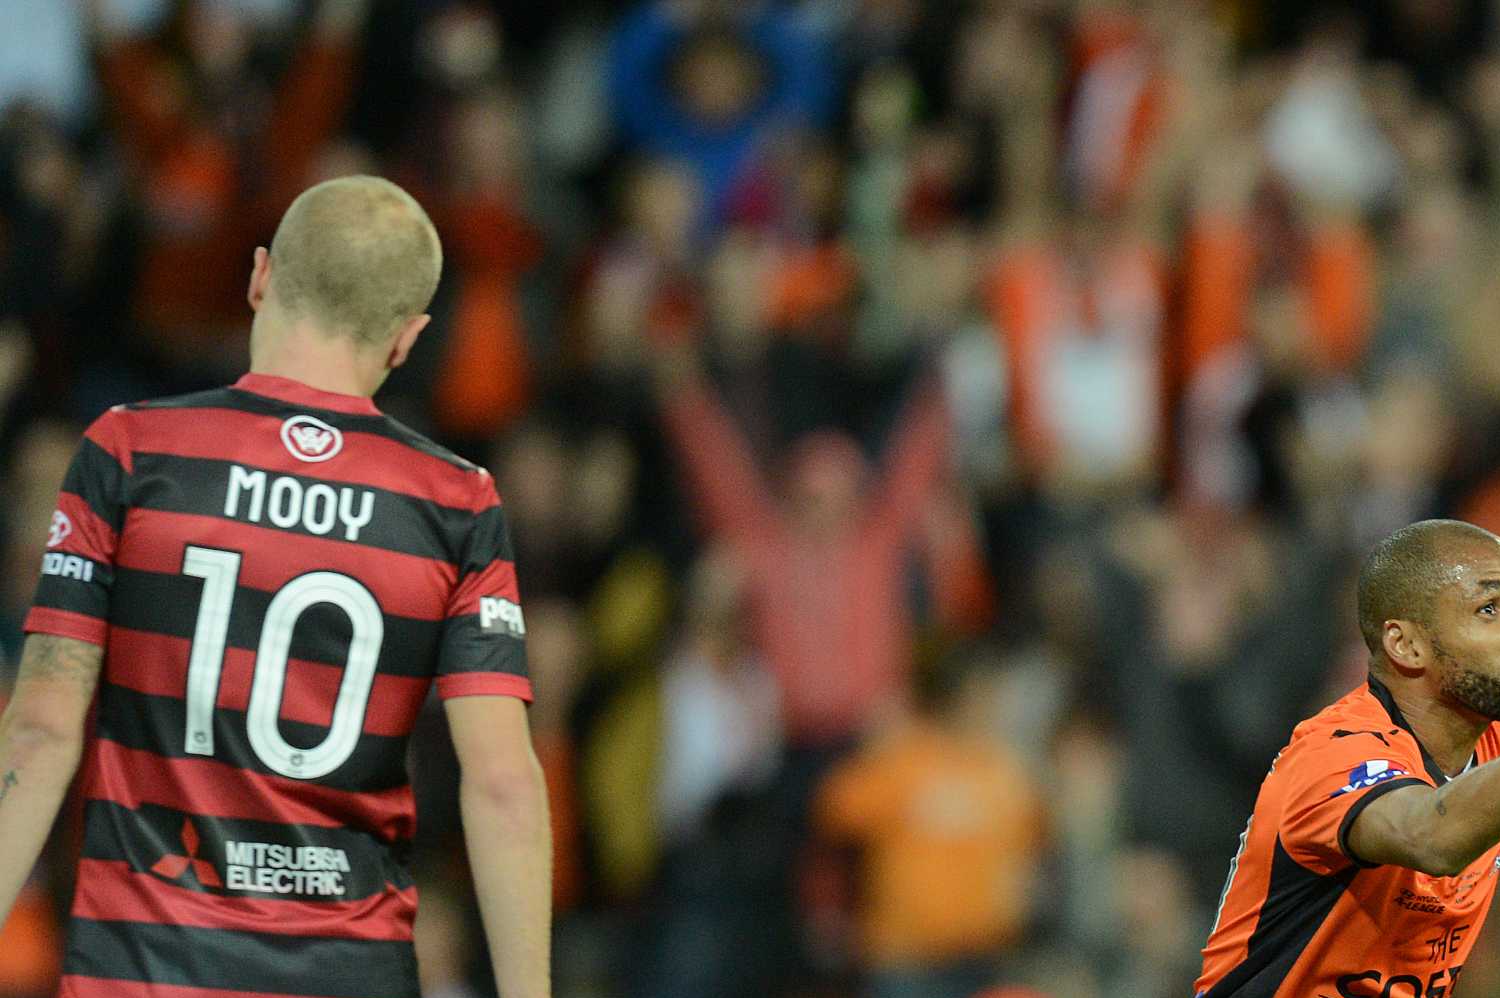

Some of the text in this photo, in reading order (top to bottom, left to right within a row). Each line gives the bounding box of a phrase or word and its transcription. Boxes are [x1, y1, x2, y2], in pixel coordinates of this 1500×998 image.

[224, 464, 375, 542] MOOY
[182, 544, 385, 780] 10
[226, 864, 346, 896] ELECTRIC
[1425, 924, 1470, 964] THE
